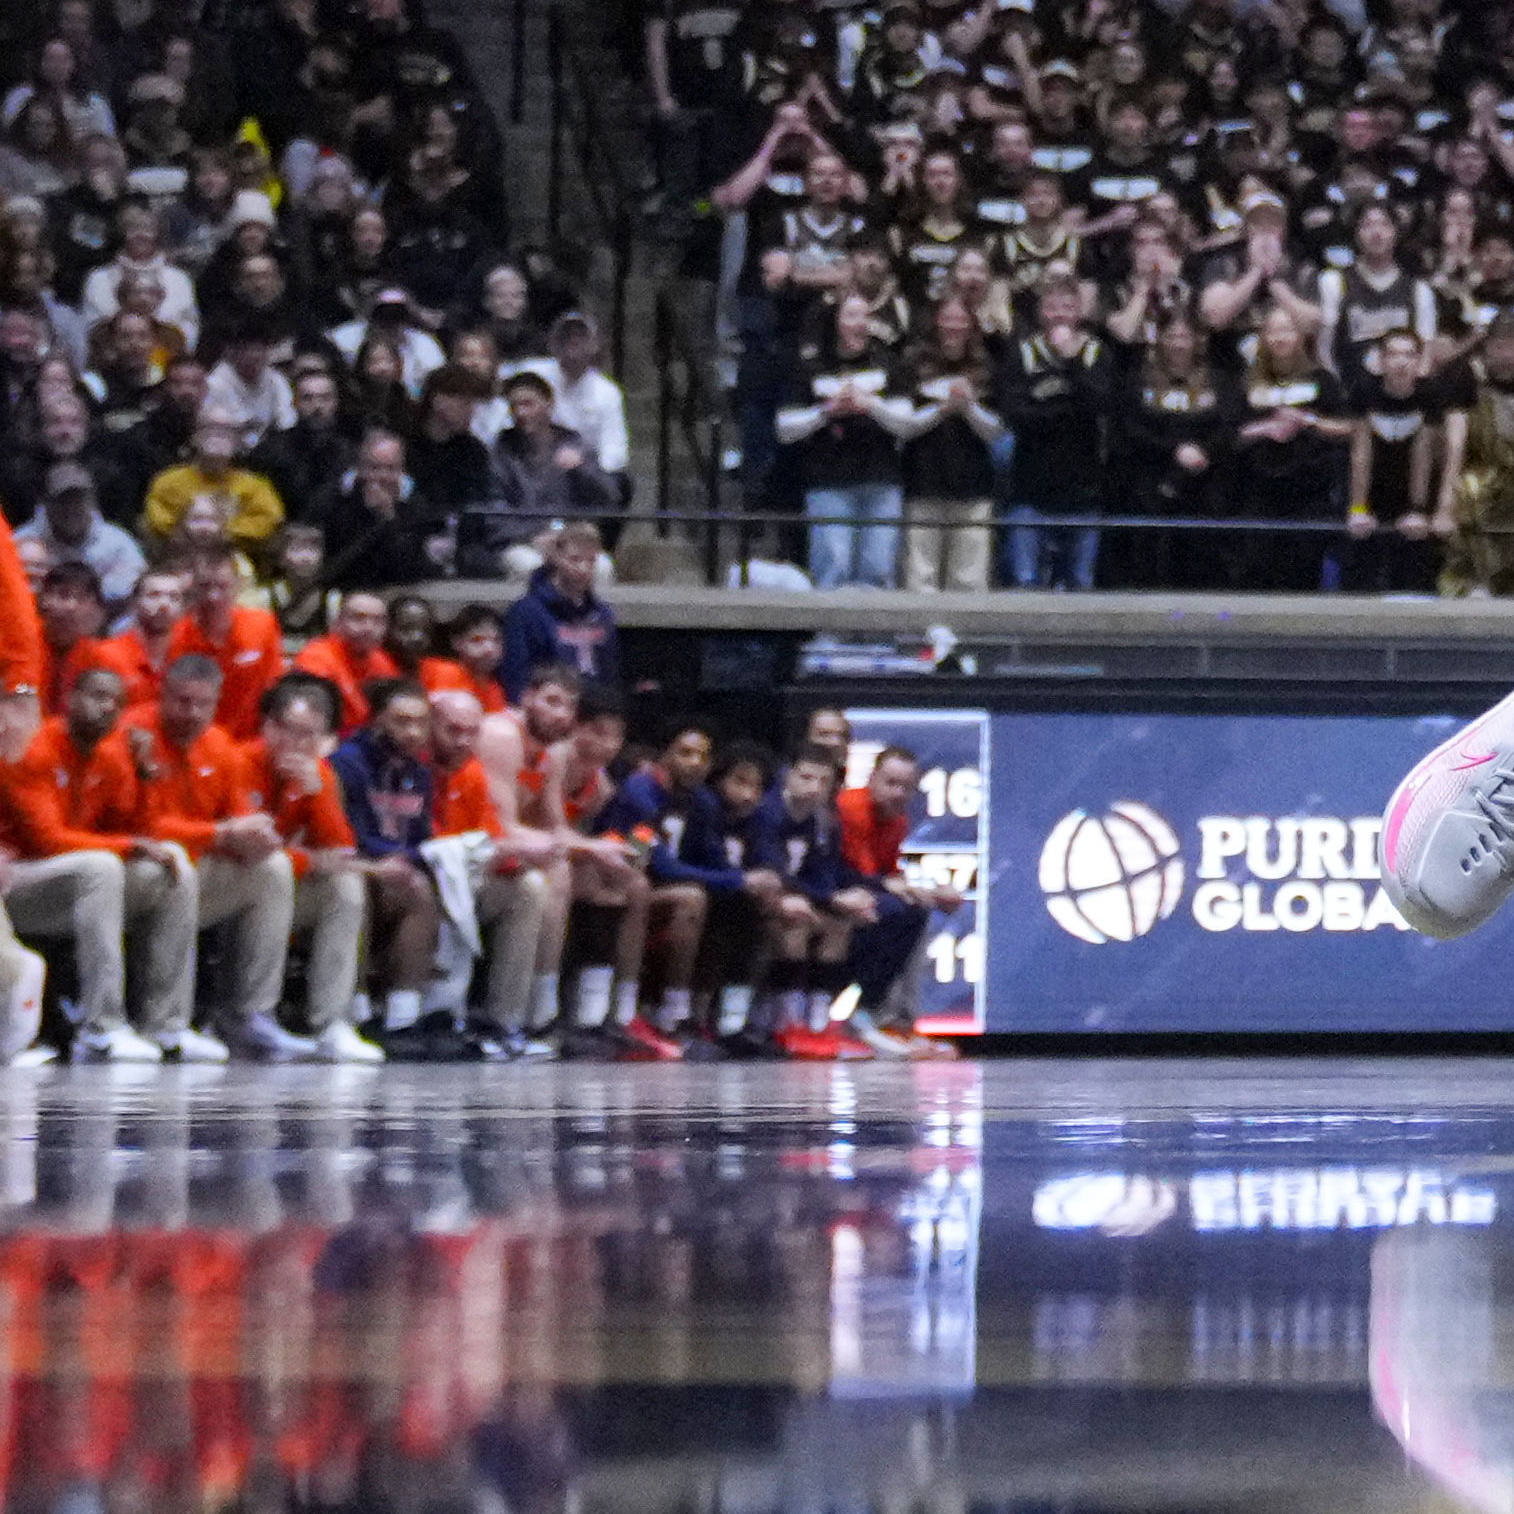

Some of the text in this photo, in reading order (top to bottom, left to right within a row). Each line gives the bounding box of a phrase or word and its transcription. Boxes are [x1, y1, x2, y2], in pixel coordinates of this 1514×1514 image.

[919, 766, 982, 818] 16
[1191, 879, 1414, 932] GLOBA
[926, 931, 983, 983] 11
